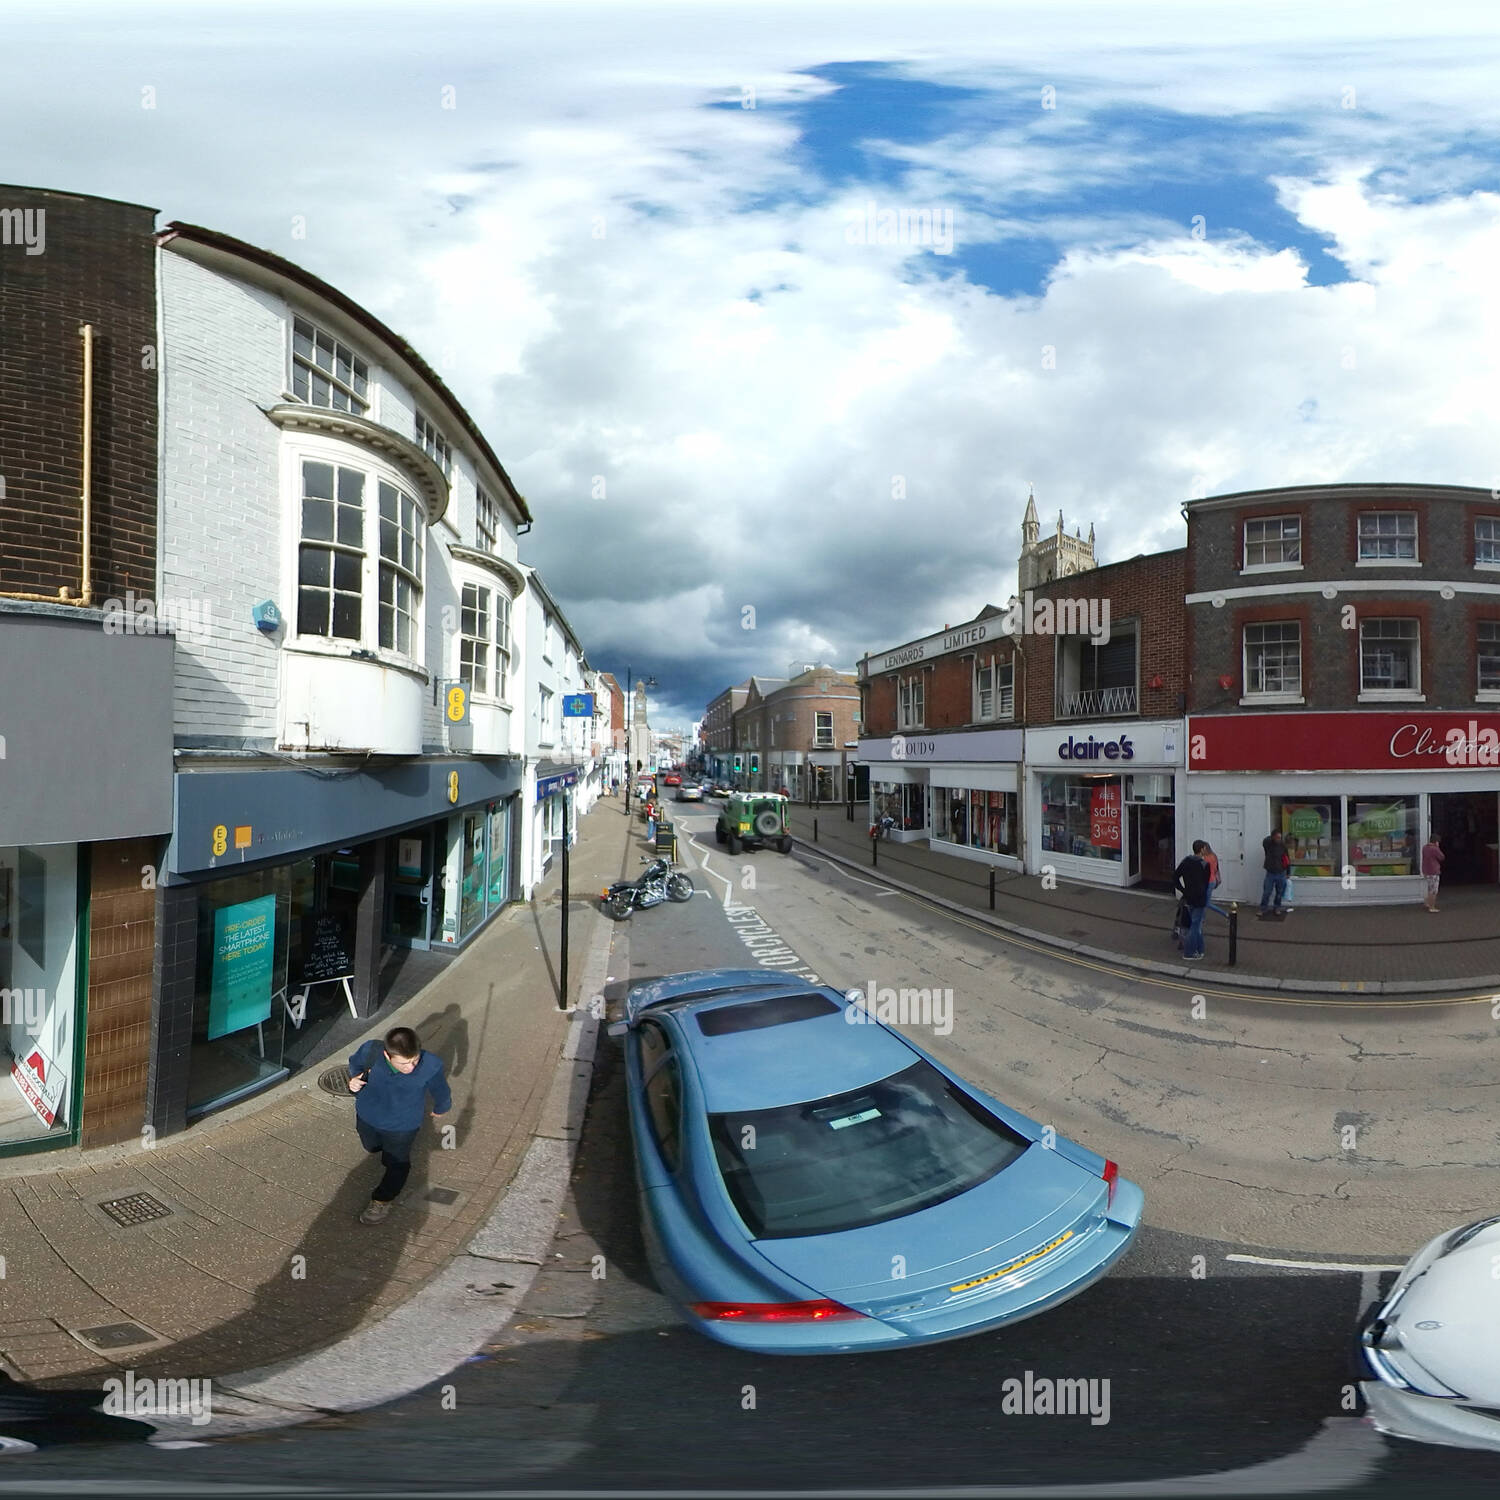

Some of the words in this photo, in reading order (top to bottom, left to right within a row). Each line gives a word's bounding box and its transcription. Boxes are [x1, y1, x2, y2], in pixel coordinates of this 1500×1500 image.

[884, 646, 924, 669] LENNARDS
[944, 625, 987, 650] LIMITED
[929, 741, 935, 754] 9
[1058, 735, 1134, 760] claire's
[1099, 792, 1115, 801] FREE
[1094, 801, 1118, 818] sale
[1094, 824, 1101, 838] 3
[1295, 820, 1316, 828] NEW
[224, 915, 266, 933] PRE-ORDER
[224, 932, 240, 943] THE
[240, 924, 266, 939] LATEST
[219, 931, 270, 955] SMARTPHONE
[222, 950, 241, 962] HERE
[241, 941, 267, 956] TODAY
